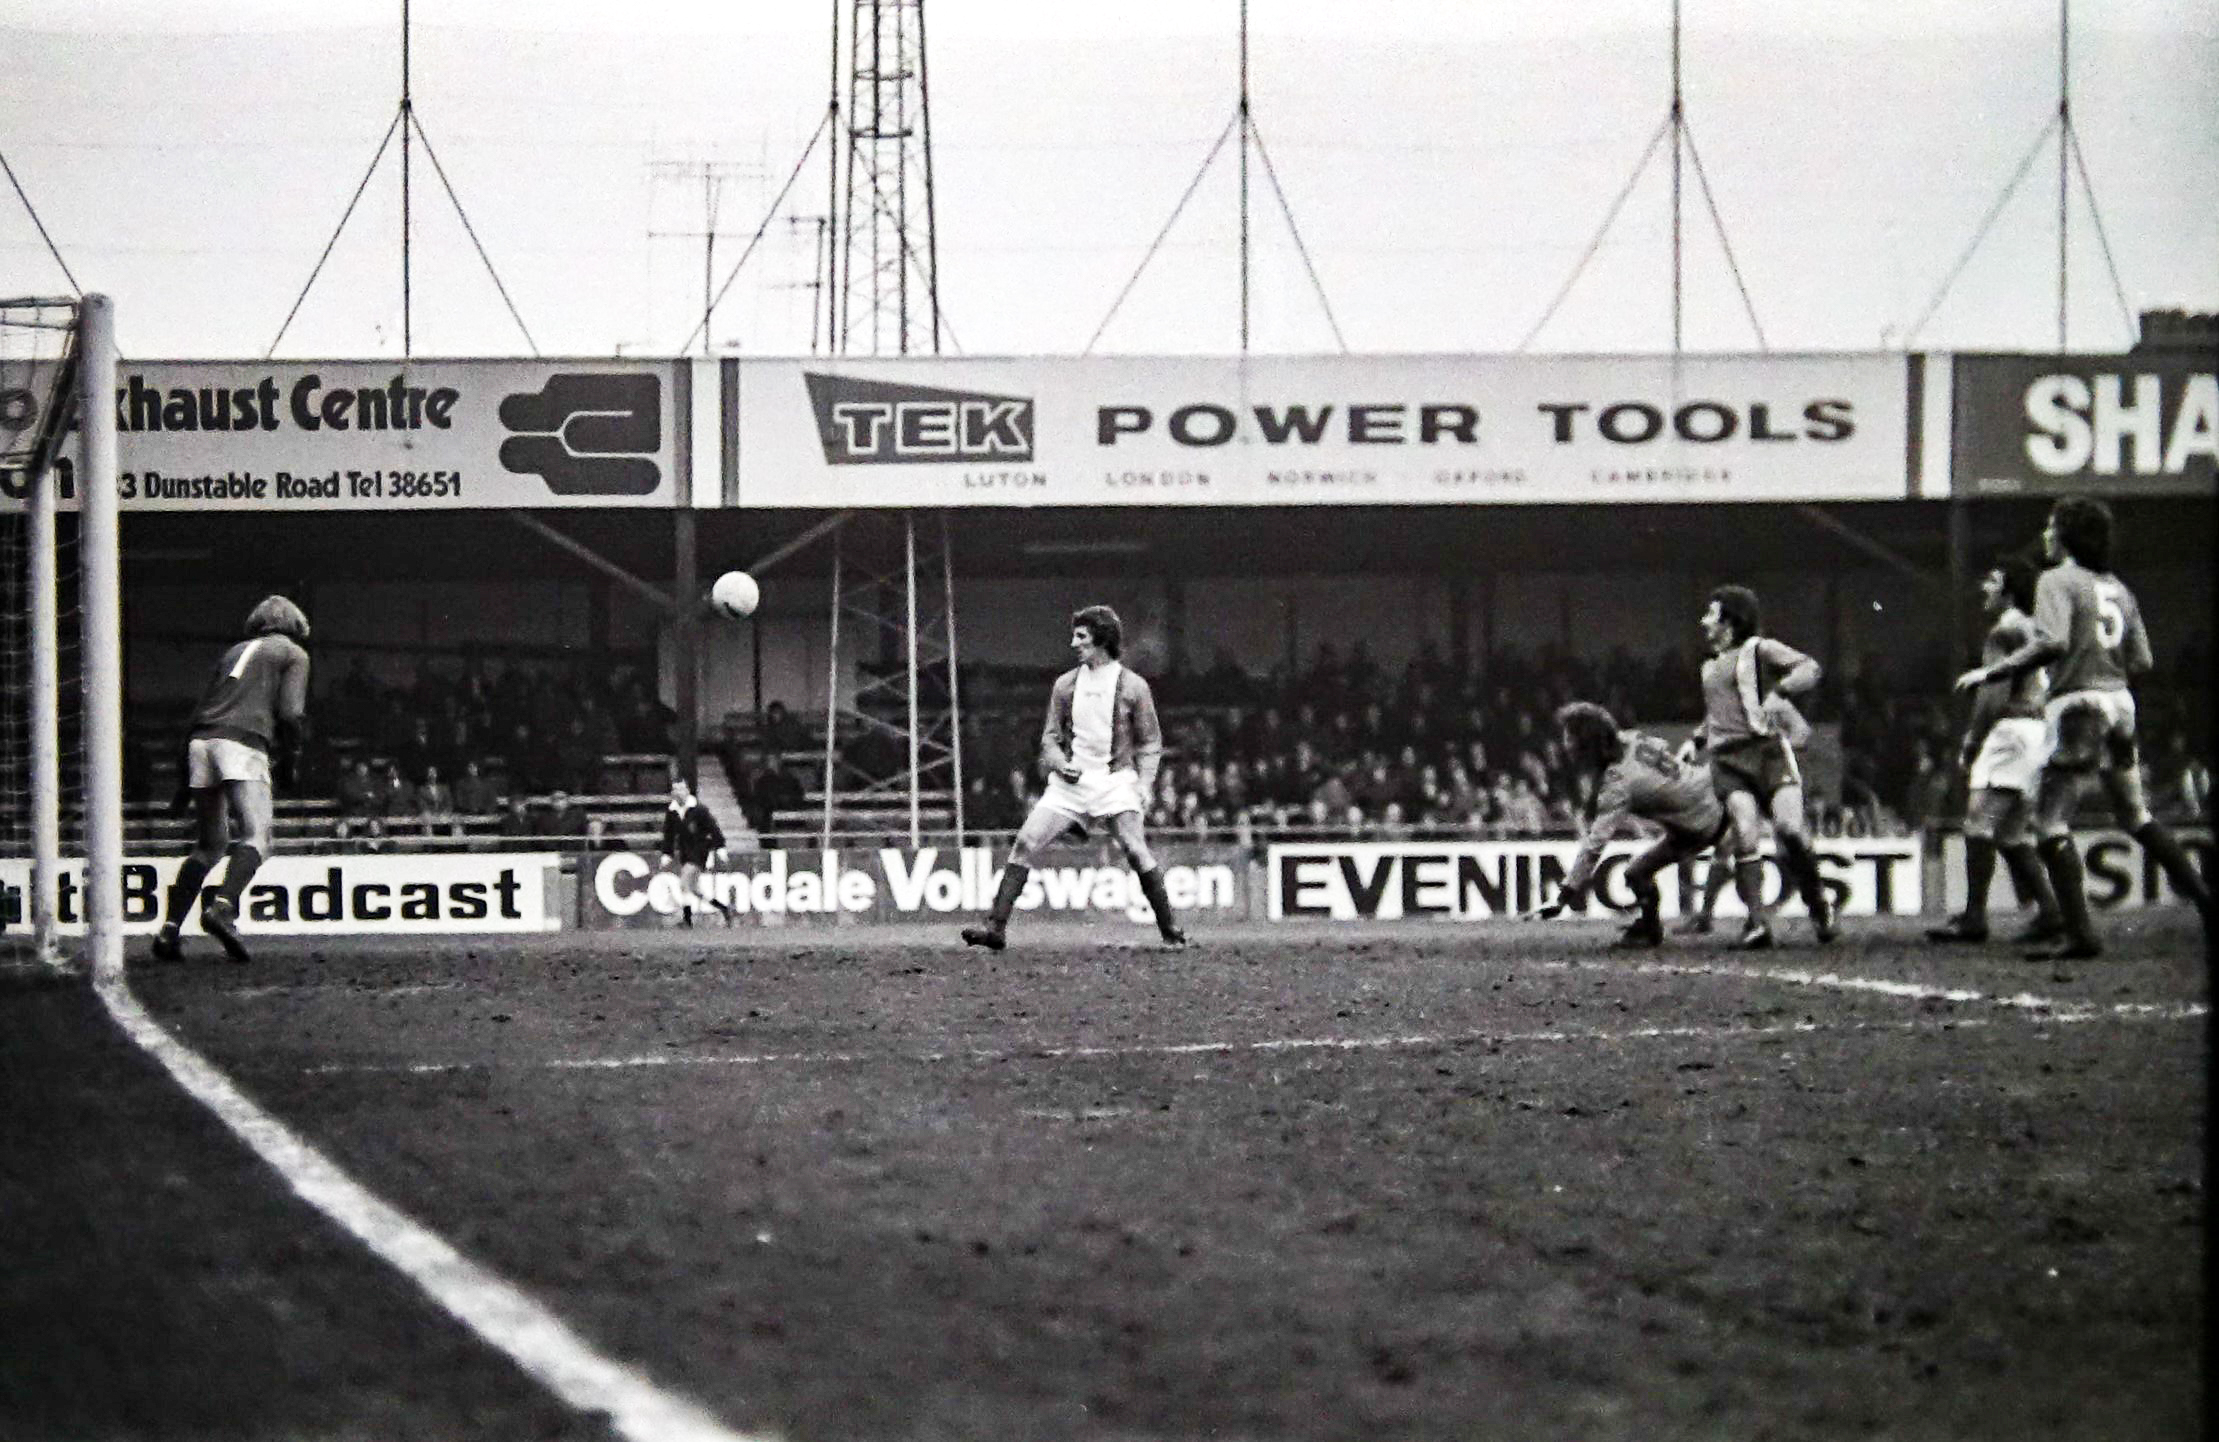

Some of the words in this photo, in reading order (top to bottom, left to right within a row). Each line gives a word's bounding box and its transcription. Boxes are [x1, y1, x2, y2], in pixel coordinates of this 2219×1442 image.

[290, 374, 461, 431] Centre
[833, 402, 1029, 456] TEK
[1098, 403, 1480, 447] POWER
[1537, 400, 1856, 443] TOOLS
[144, 471, 267, 498] Dunstable
[276, 471, 340, 498] Road
[346, 470, 382, 498] Tel
[388, 470, 462, 497] 38651
[964, 471, 1047, 488] LUTON
[2095, 582, 2125, 650] 5
[122, 864, 522, 923] Badcast
